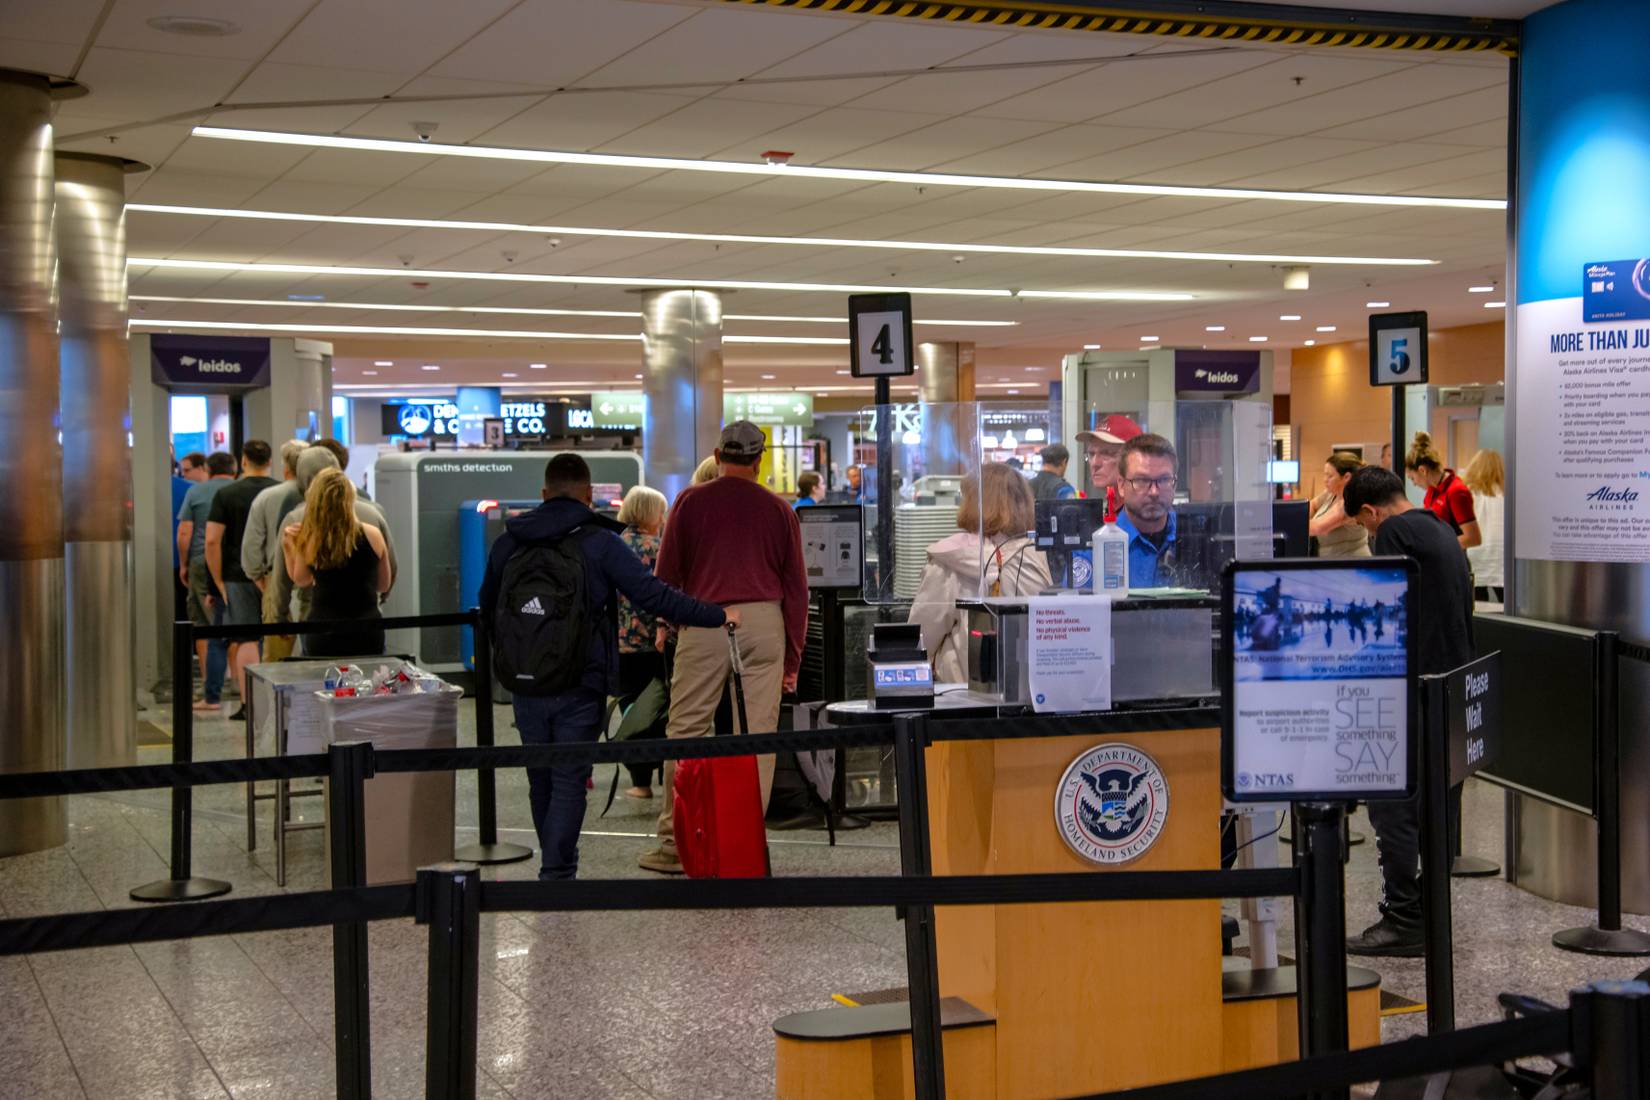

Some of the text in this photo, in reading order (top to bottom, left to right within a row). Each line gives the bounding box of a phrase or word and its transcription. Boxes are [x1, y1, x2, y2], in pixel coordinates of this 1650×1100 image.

[871, 323, 894, 364] 4
[1551, 332, 1584, 353] MORE
[1588, 329, 1628, 351] THAN
[1390, 338, 1410, 375] 5
[198, 359, 241, 373] leidos
[1208, 371, 1238, 383] leidos
[517, 418, 546, 433] CO.
[491, 427, 500, 440] 3
[1608, 448, 1643, 456] Companion
[424, 462, 512, 472] smiths detection
[1587, 486, 1639, 503] Alaska
[521, 606, 545, 615] adidas
[1045, 626, 1067, 634] physical
[1337, 654, 1374, 662] Advisory
[1337, 685, 1369, 699] if you
[1465, 672, 1488, 701] Please
[1303, 709, 1329, 717] activity
[1335, 697, 1396, 729] SEE
[1465, 701, 1482, 733] Wait
[1336, 729, 1396, 742] something
[1335, 742, 1399, 773] SAY
[1466, 738, 1484, 765] Here
[1083, 750, 1158, 778] DEPARTMENT
[1152, 779, 1164, 794] OF
[1254, 774, 1294, 786] NTAS
[1063, 809, 1164, 860] HOMELAND SECURITY
